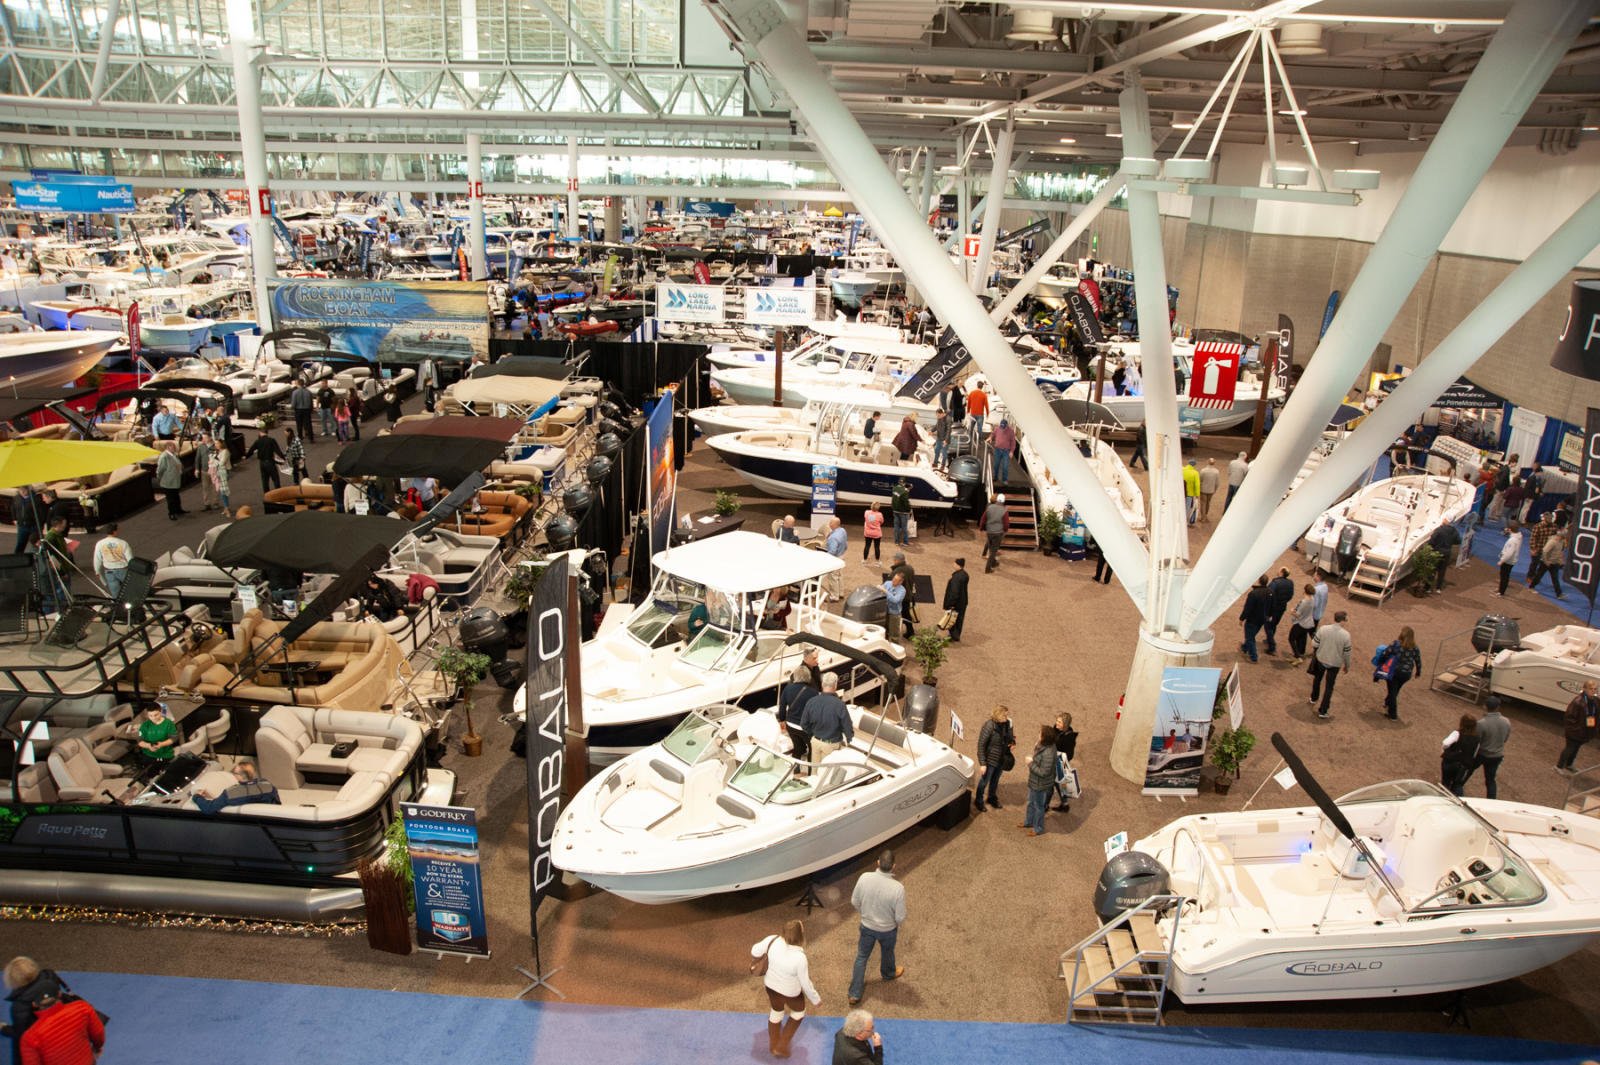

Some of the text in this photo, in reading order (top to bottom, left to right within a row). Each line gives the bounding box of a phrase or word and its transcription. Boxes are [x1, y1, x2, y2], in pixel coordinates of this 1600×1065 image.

[300, 287, 396, 303] ROCKINGHAM
[325, 303, 371, 316] BOAT
[914, 346, 968, 400] ROBALO
[533, 607, 563, 893] ROBALO
[420, 809, 467, 820] GODFREY
[440, 867, 463, 875] YEAR
[420, 876, 470, 886] WARRANTY
[427, 883, 443, 898] &
[442, 912, 460, 926] 10
[434, 923, 469, 932] WARRANTY
[1304, 961, 1383, 973] ROBALO
